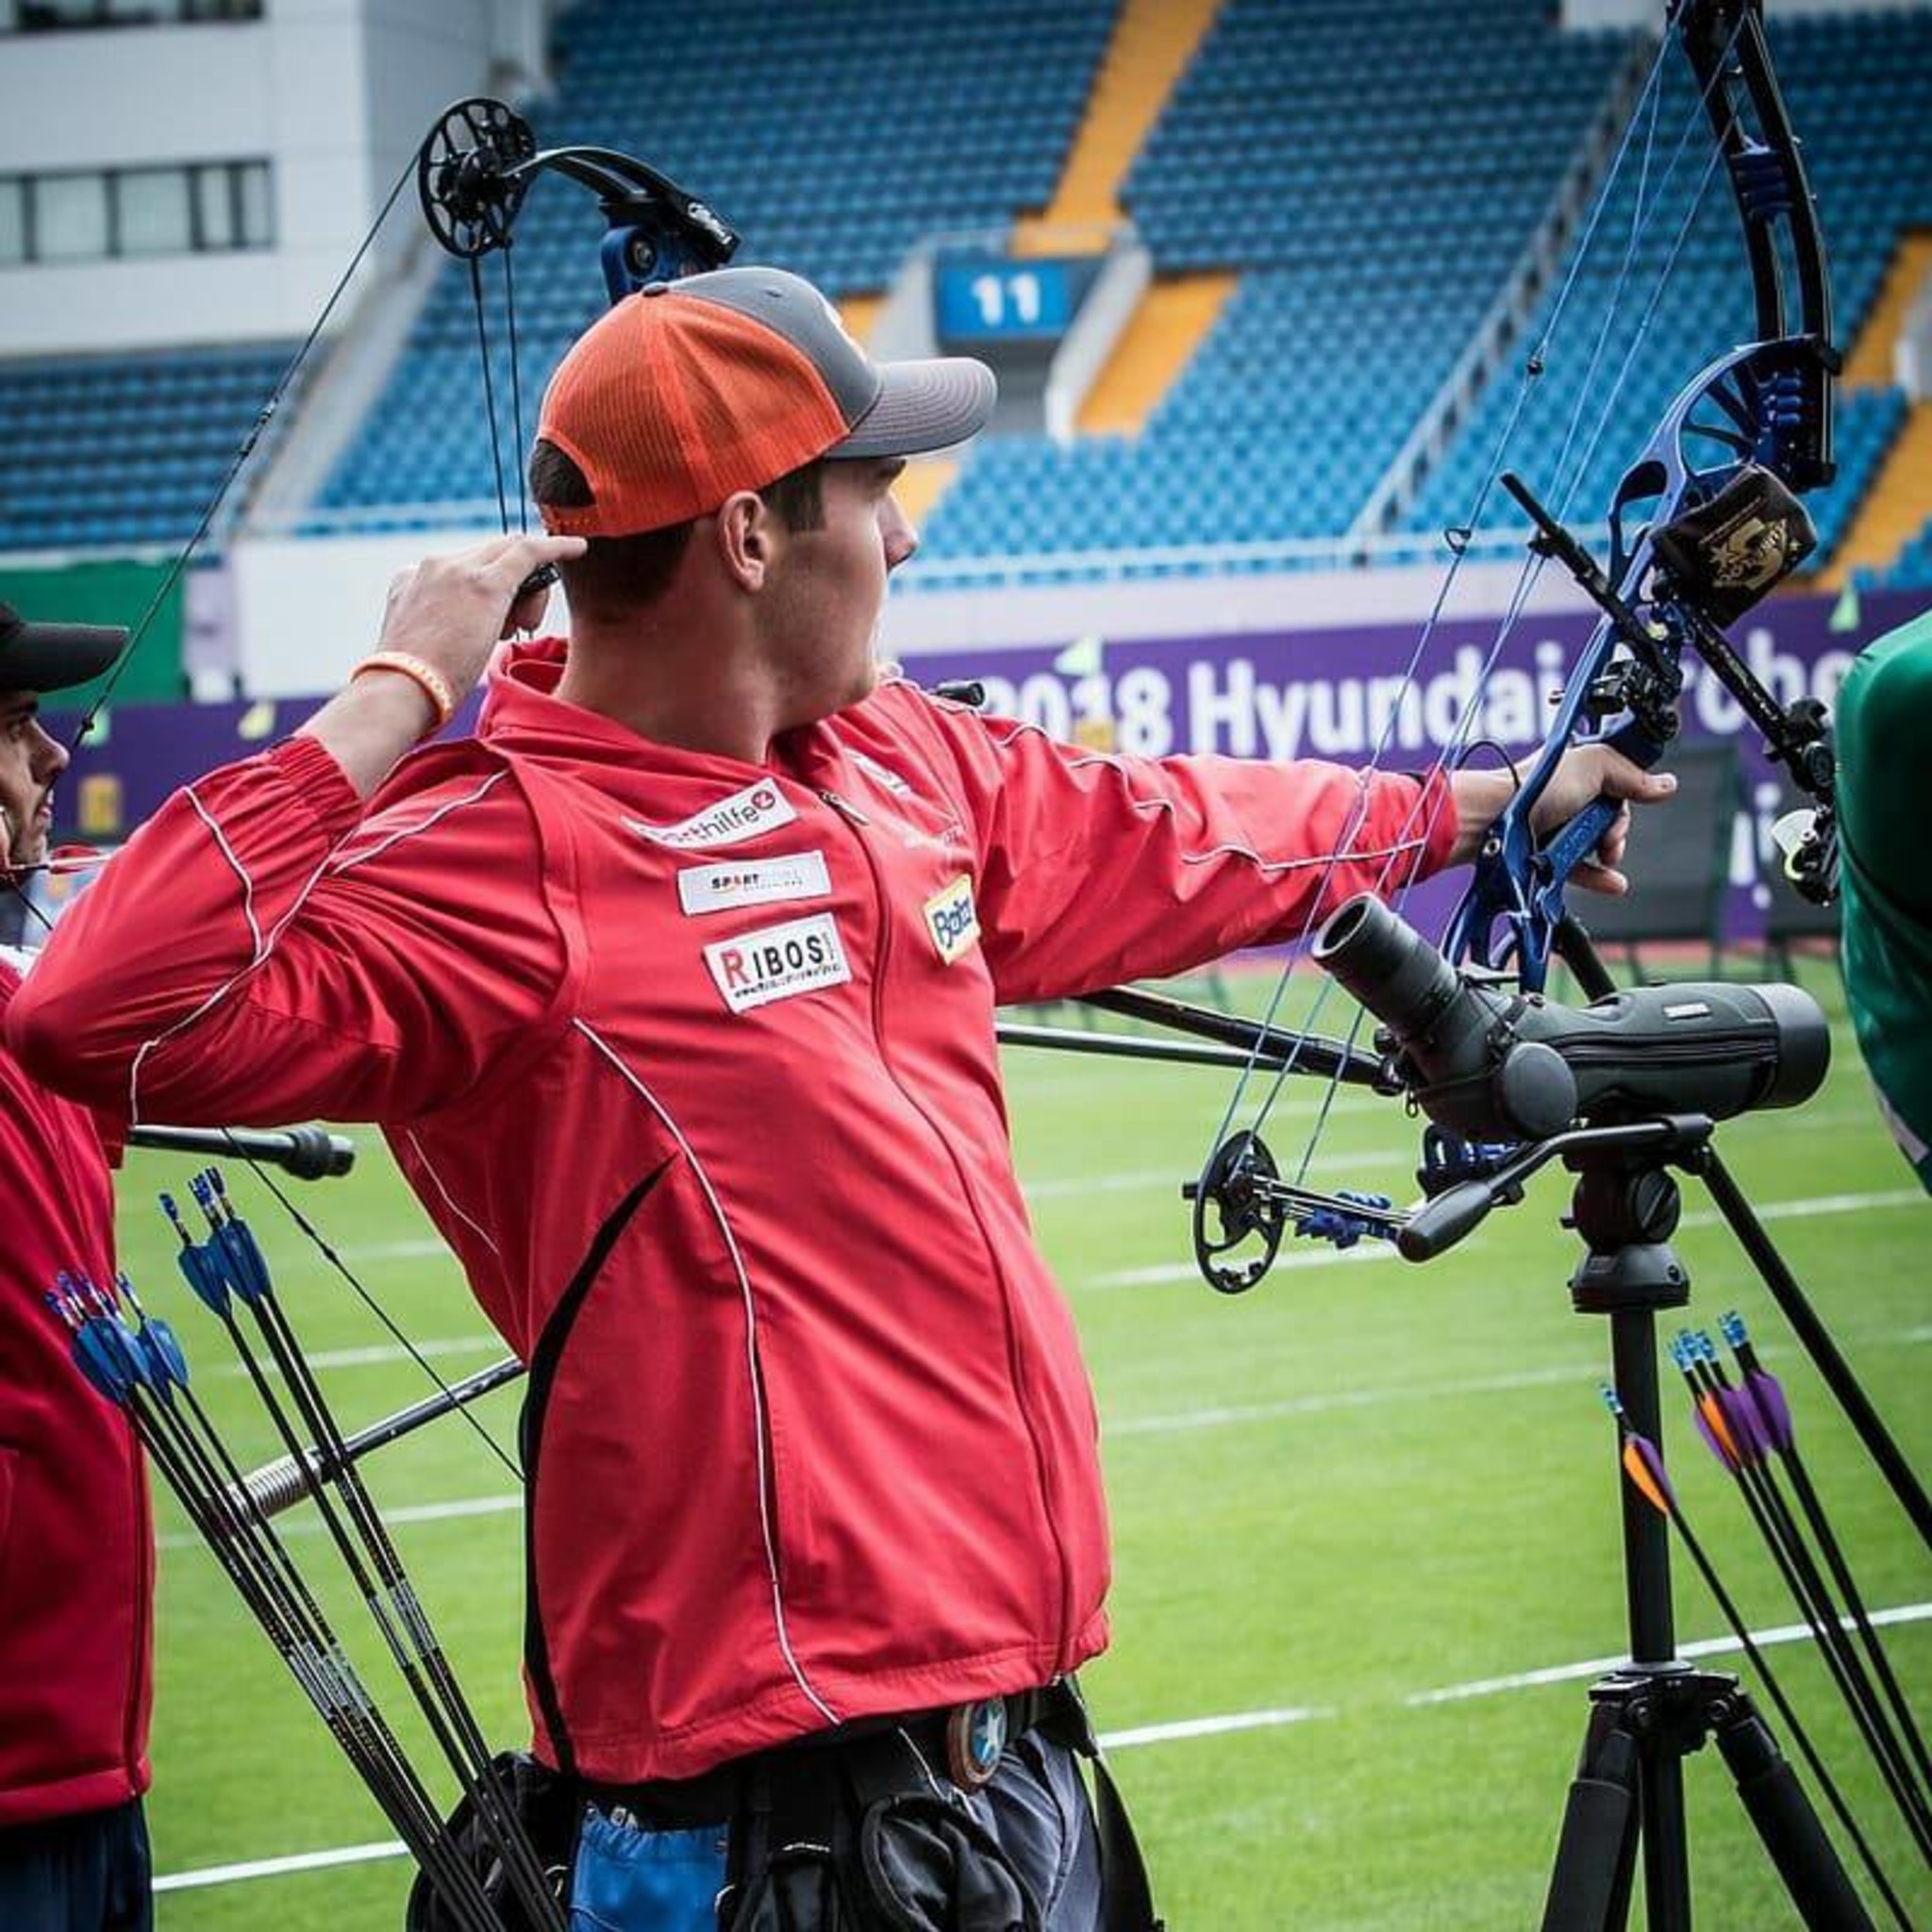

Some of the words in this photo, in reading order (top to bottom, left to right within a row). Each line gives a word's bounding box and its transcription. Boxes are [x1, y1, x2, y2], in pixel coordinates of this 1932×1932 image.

[971, 272, 1041, 326] 11
[1187, 642, 1568, 759] Hyundai
[720, 934, 824, 990] RIBOS
